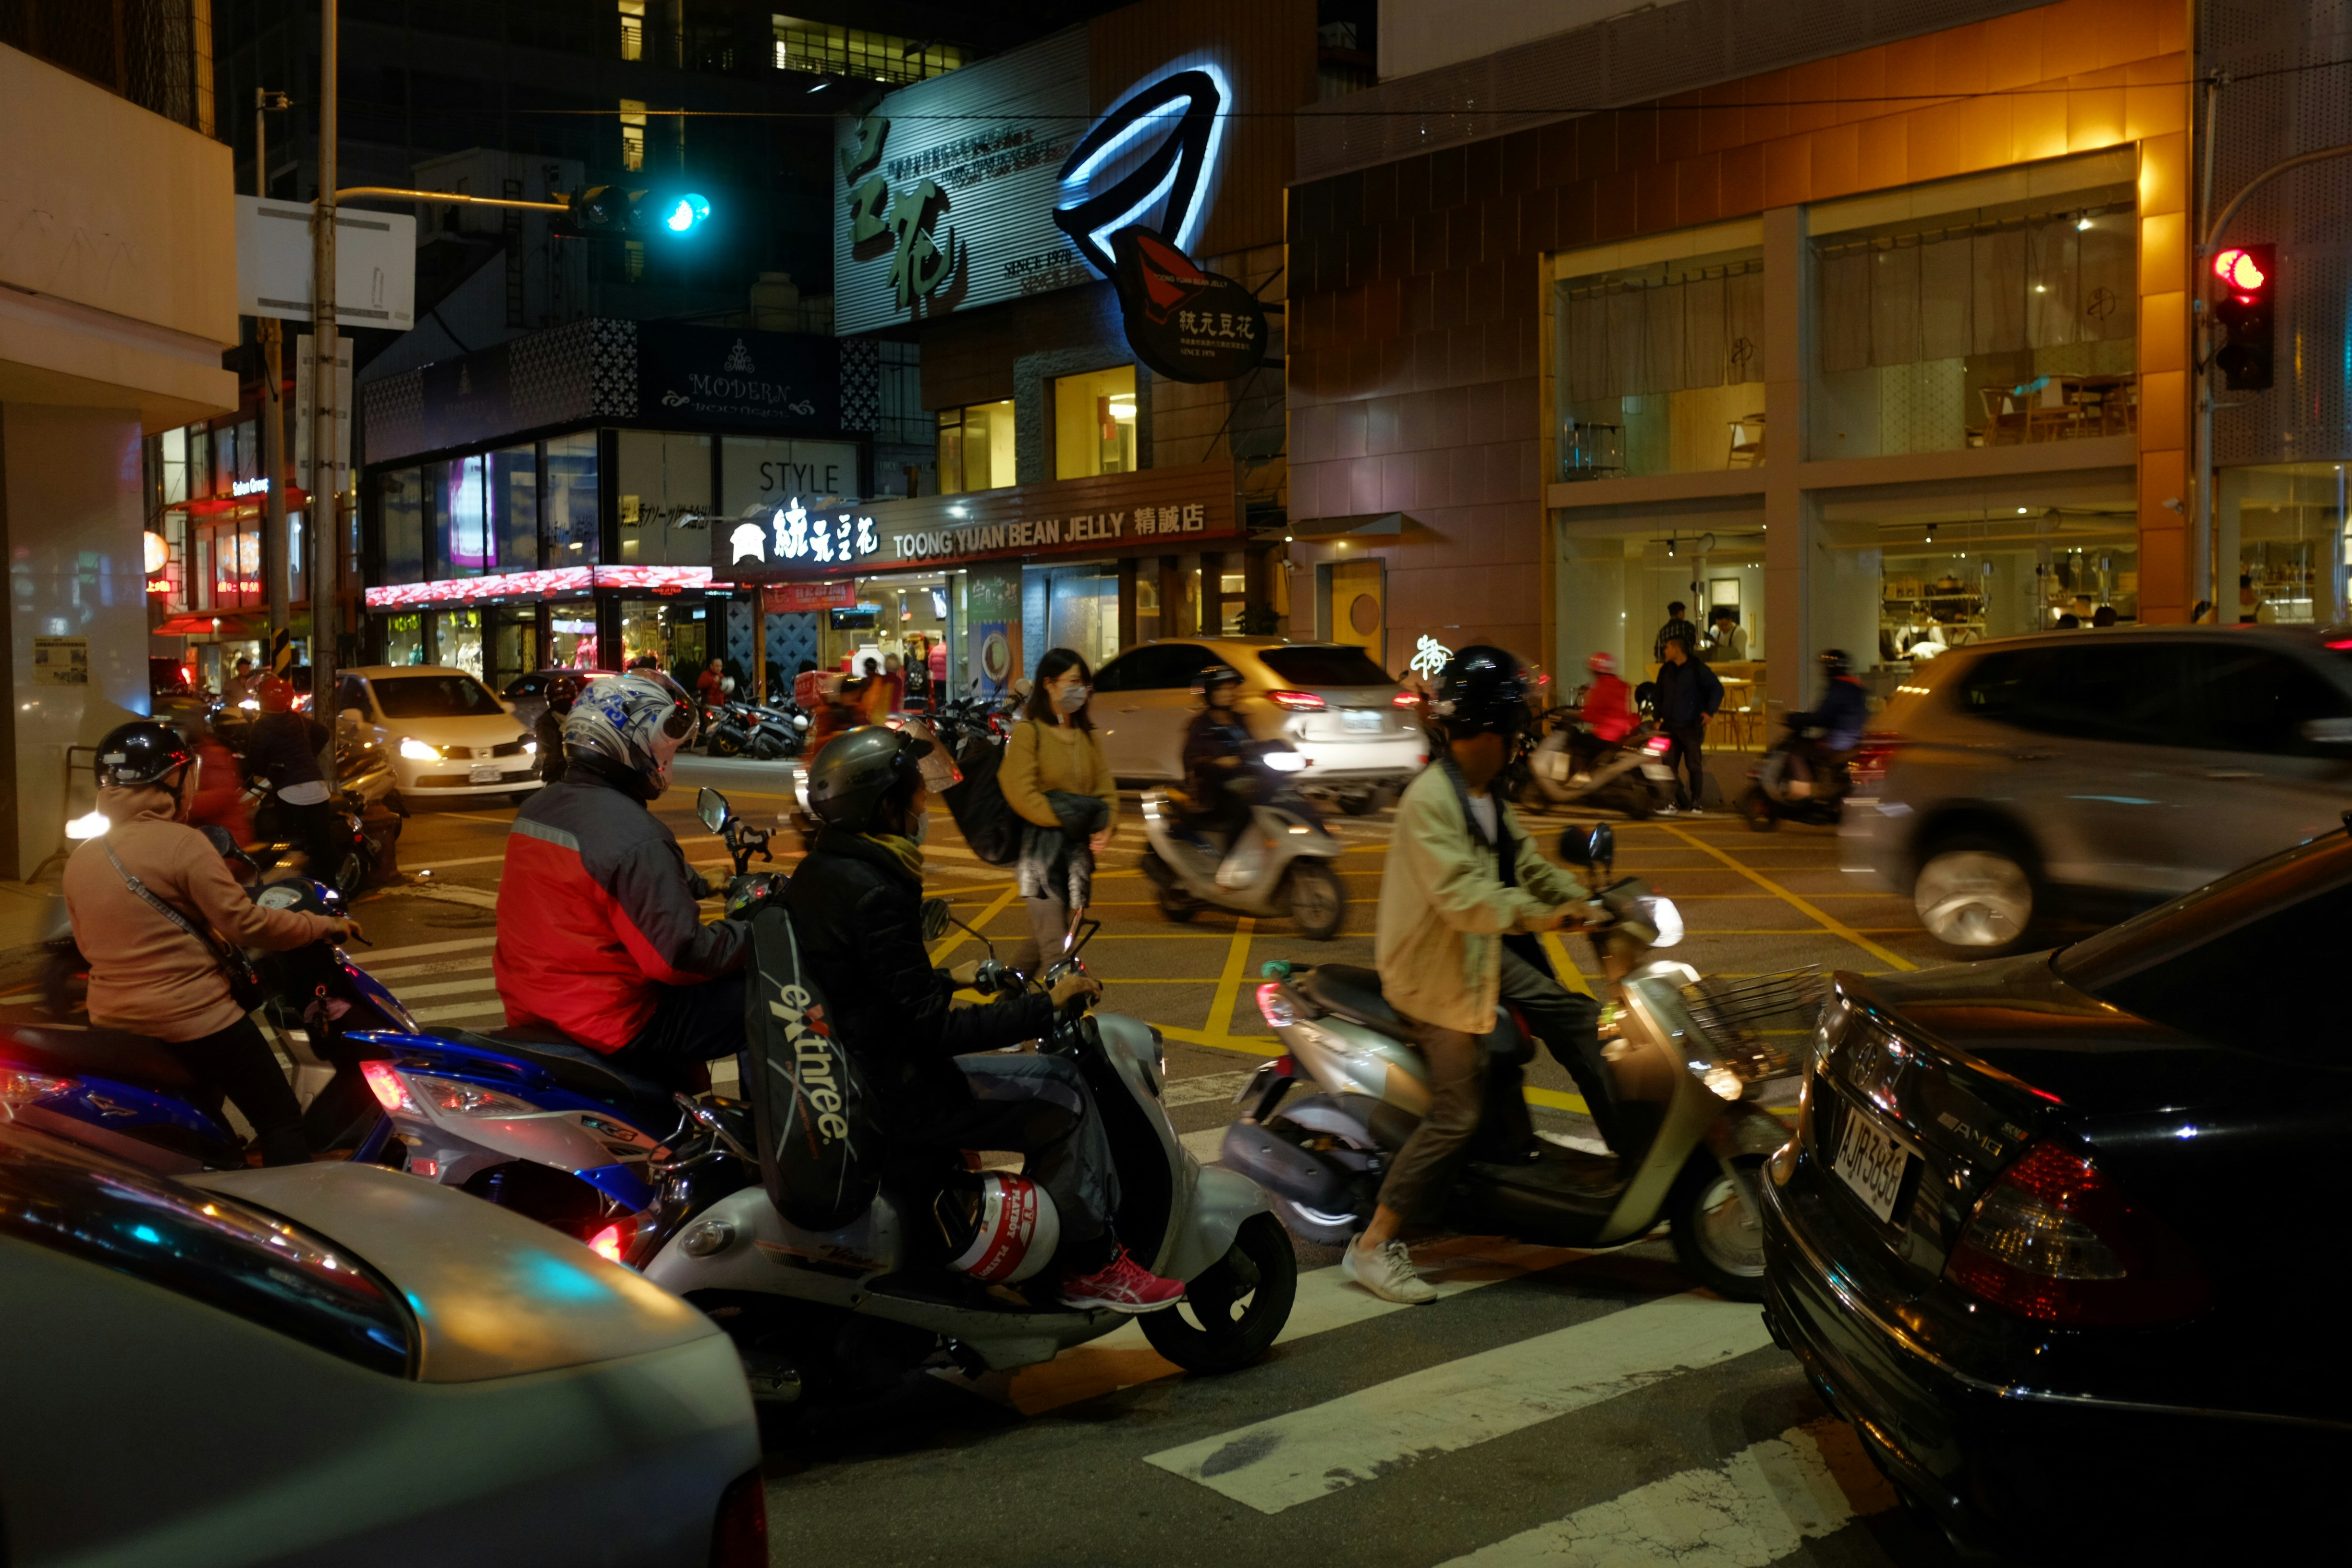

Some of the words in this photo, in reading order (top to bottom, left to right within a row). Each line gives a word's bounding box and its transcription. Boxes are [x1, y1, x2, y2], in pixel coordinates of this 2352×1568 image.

[1004, 255, 1042, 276] SINCE
[1047, 248, 1072, 266] 1970
[1154, 274, 1175, 283] TOONG
[1176, 276, 1192, 284] YUAN
[1193, 278, 1209, 286] BEAN
[1210, 280, 1228, 288] JELLY
[1179, 309, 1255, 340] 統元豆花
[1180, 348, 1200, 356] SINCE
[688, 373, 791, 405] MODERN
[760, 462, 839, 495] STYLE
[772, 496, 878, 562] 統元豆花
[893, 530, 953, 558] TOONG
[956, 525, 1005, 552] YUAN
[1009, 519, 1059, 547] BEAN
[1064, 512, 1125, 542] JELLY
[1134, 503, 1205, 536] 精誠店
[794, 1093, 812, 1131] BADMINTON
[1954, 1122, 2003, 1157] AMG
[1006, 1189, 1021, 1238] PLAYBOY
[981, 1244, 1009, 1276] PLAYBOY
